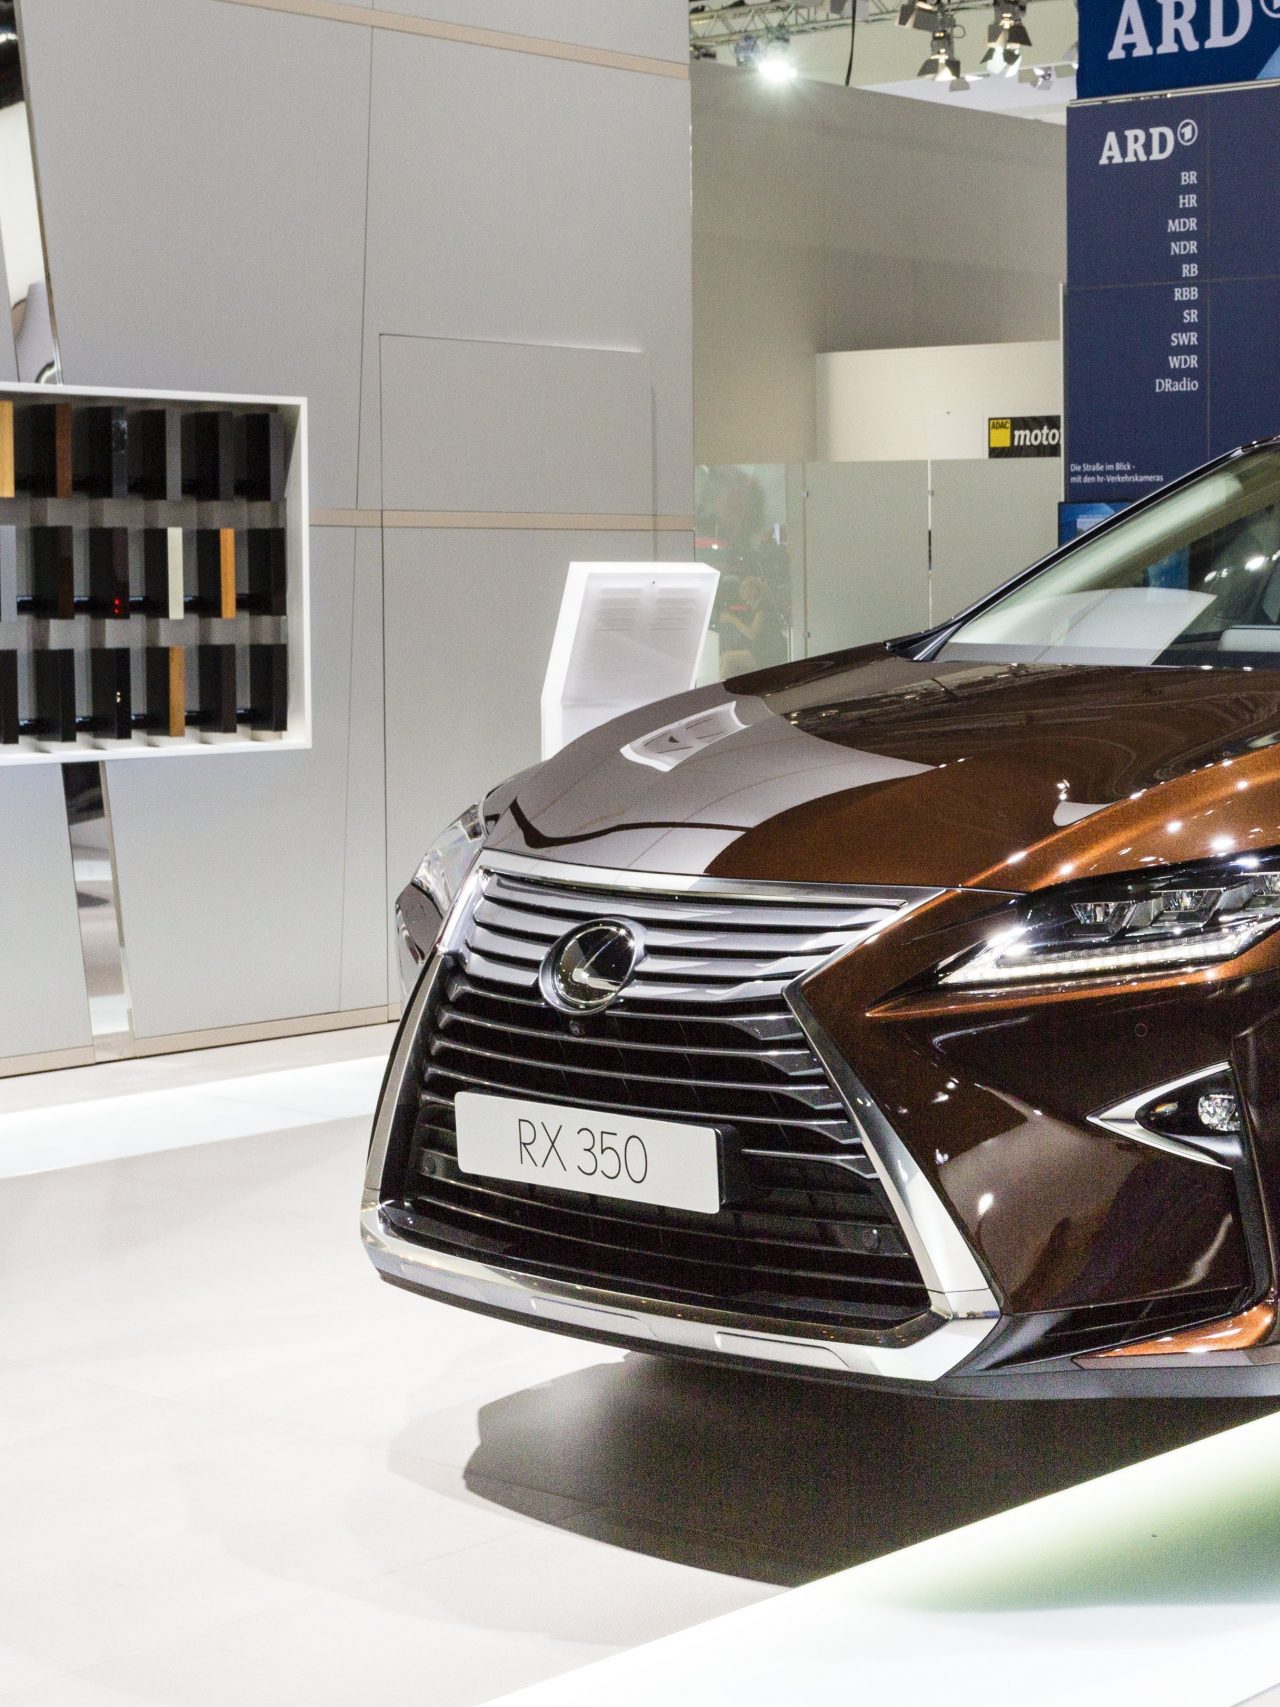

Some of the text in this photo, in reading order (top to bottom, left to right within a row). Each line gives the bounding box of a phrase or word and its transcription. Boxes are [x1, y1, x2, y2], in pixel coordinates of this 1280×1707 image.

[1107, 0, 1253, 60] ARD
[1099, 126, 1175, 165] ARD
[1181, 171, 1198, 185] BR
[1179, 194, 1198, 208] HR
[1167, 218, 1198, 232] MDR
[1170, 240, 1198, 255] NDR
[1182, 264, 1198, 277] RB
[1174, 287, 1199, 301] RBB
[1183, 309, 1198, 323] SR
[1171, 332, 1198, 346] SWR
[1169, 354, 1198, 369] WDR
[1155, 377, 1199, 392] DRadio
[991, 421, 1009, 429] ADAC
[1013, 425, 1061, 447] moto
[1070, 463, 1081, 472] Die
[1083, 463, 1105, 472] Straße
[1105, 462, 1115, 471] im
[1115, 462, 1132, 471] Blick
[1070, 473, 1164, 483] mit den hr-Verkehrskameras
[518, 1118, 648, 1184] RX 350
